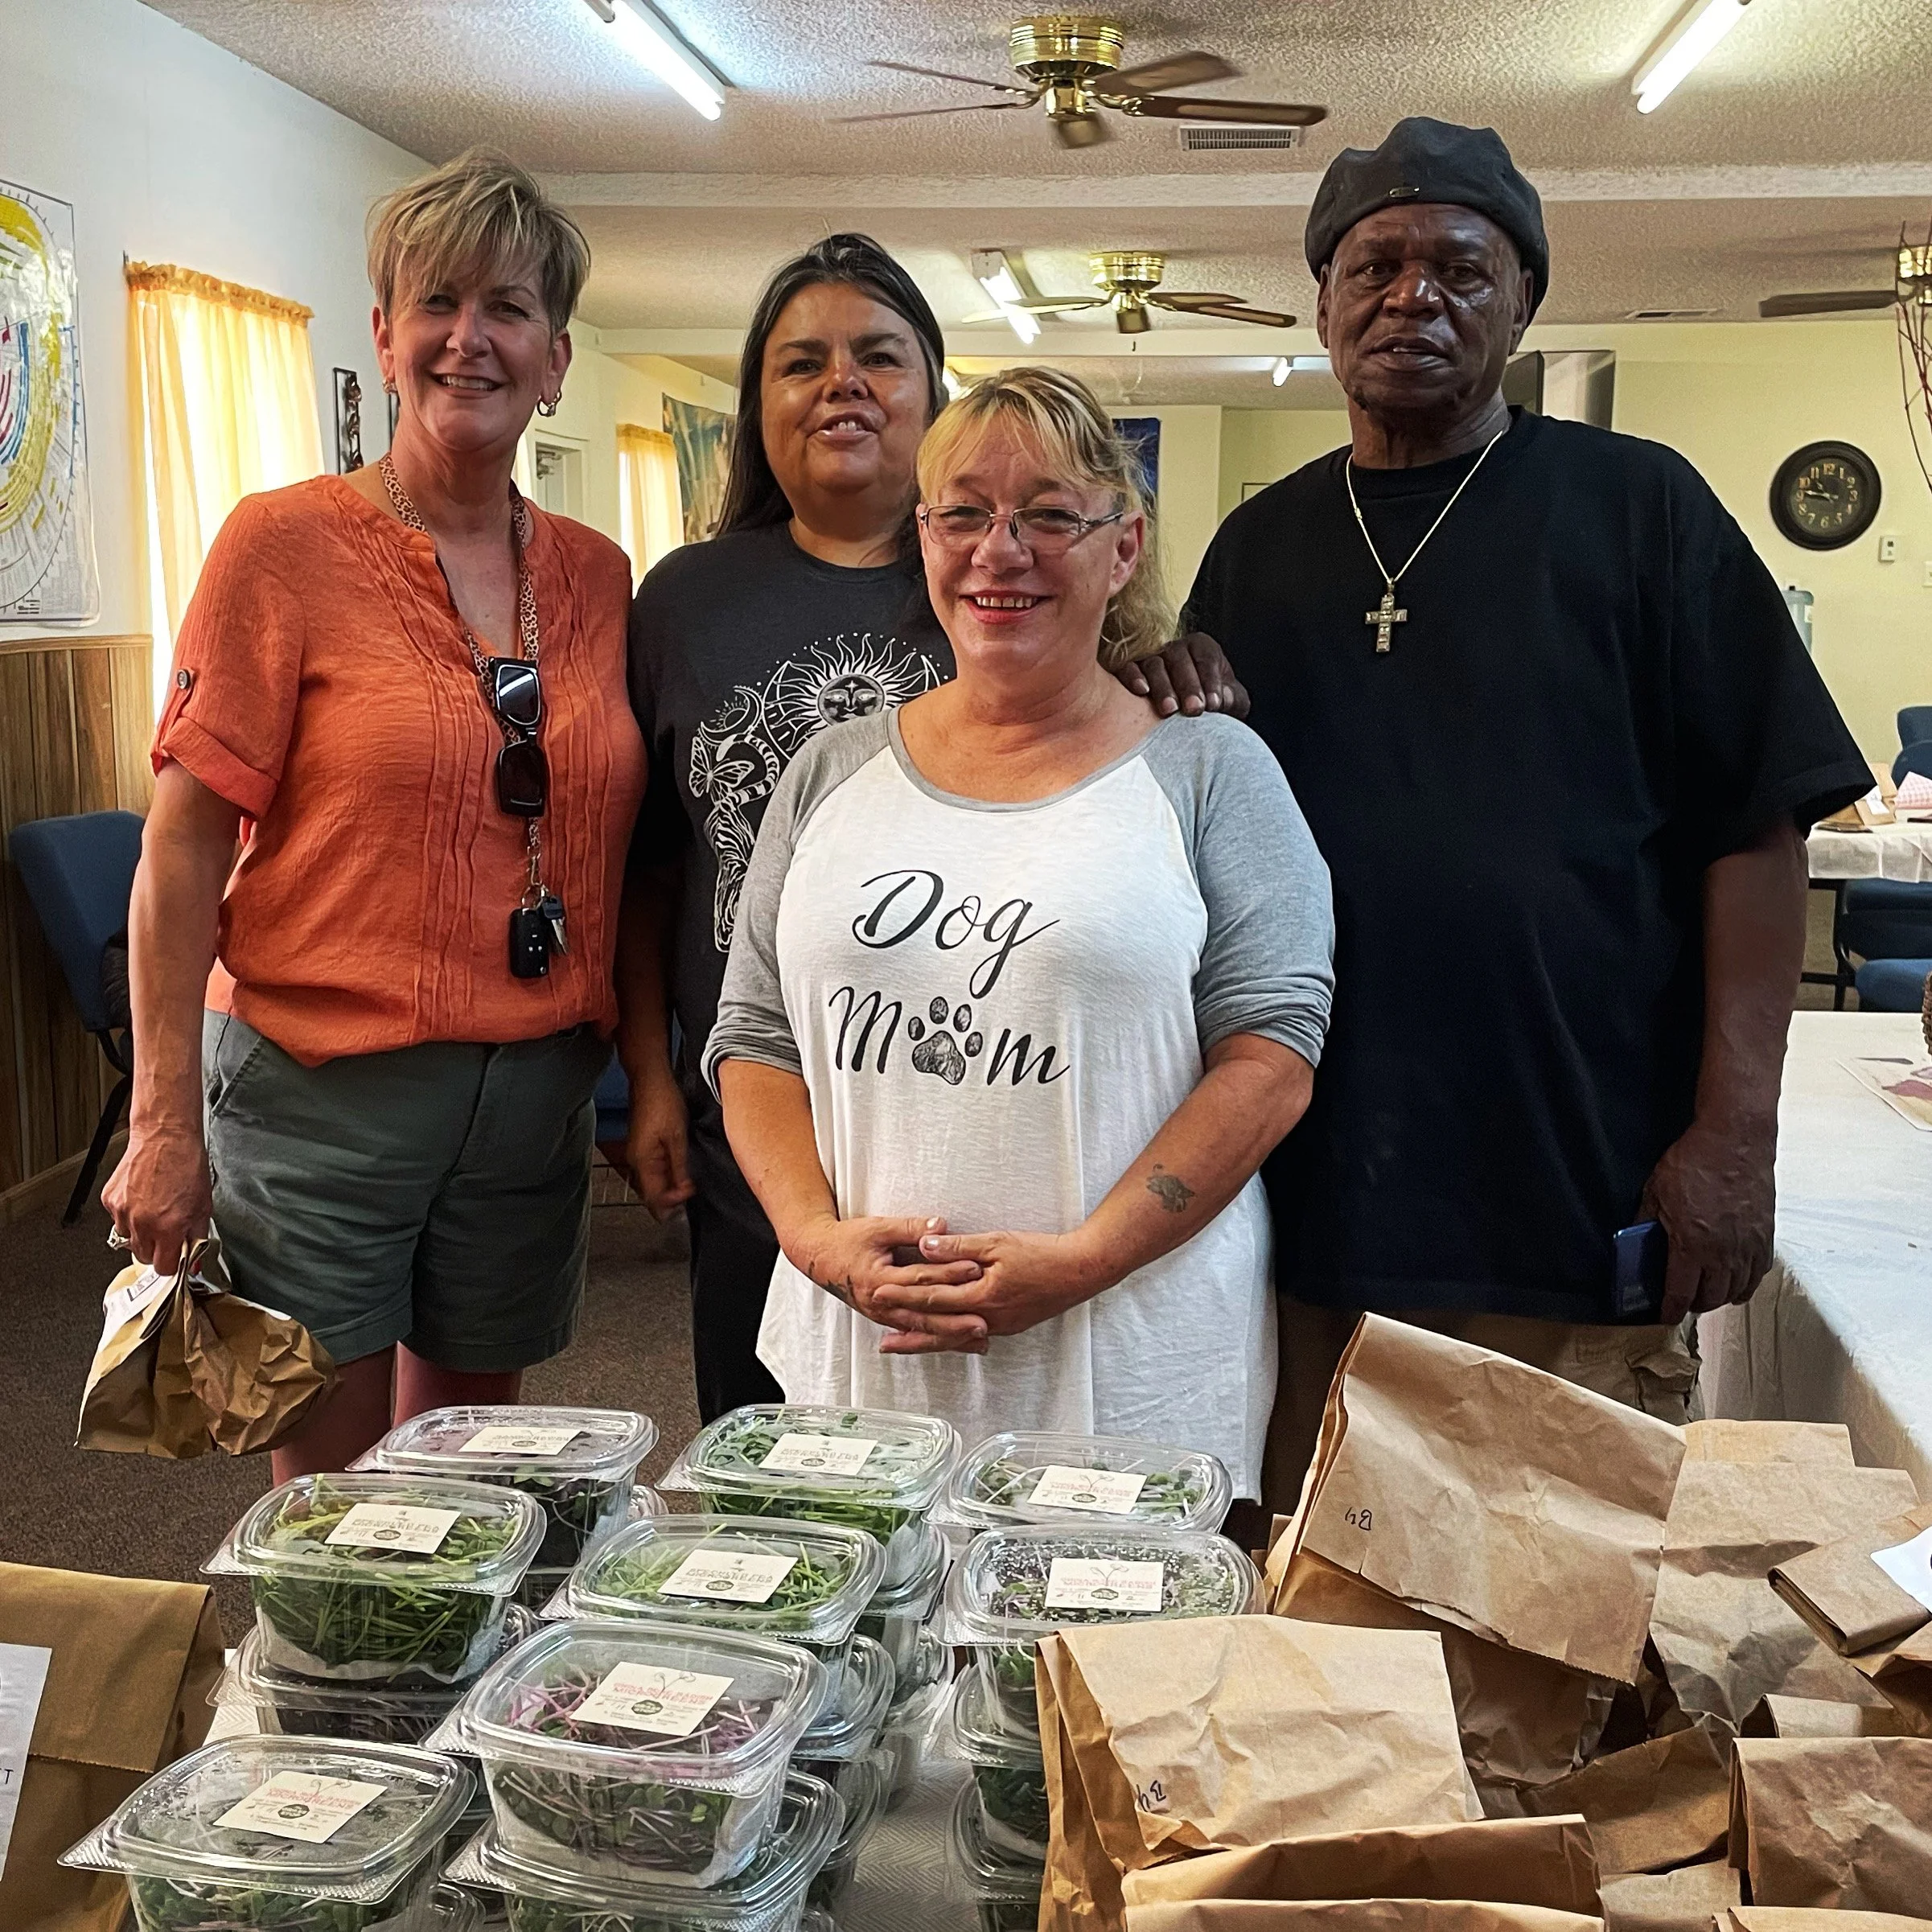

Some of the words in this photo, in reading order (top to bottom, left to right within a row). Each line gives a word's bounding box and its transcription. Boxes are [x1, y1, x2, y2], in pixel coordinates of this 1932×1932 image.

[1811, 467, 1819, 479] 11
[1823, 462, 1835, 475] 12
[1840, 467, 1844, 479] 1
[1798, 476, 1811, 489] 10
[1847, 476, 1856, 489] 2
[1795, 490, 1805, 503] 9
[1849, 490, 1858, 502] 3
[1807, 512, 1816, 525] 7
[1820, 516, 1830, 528] 6
[852, 869, 1060, 999] Dog
[828, 986, 1071, 1086] Mm
